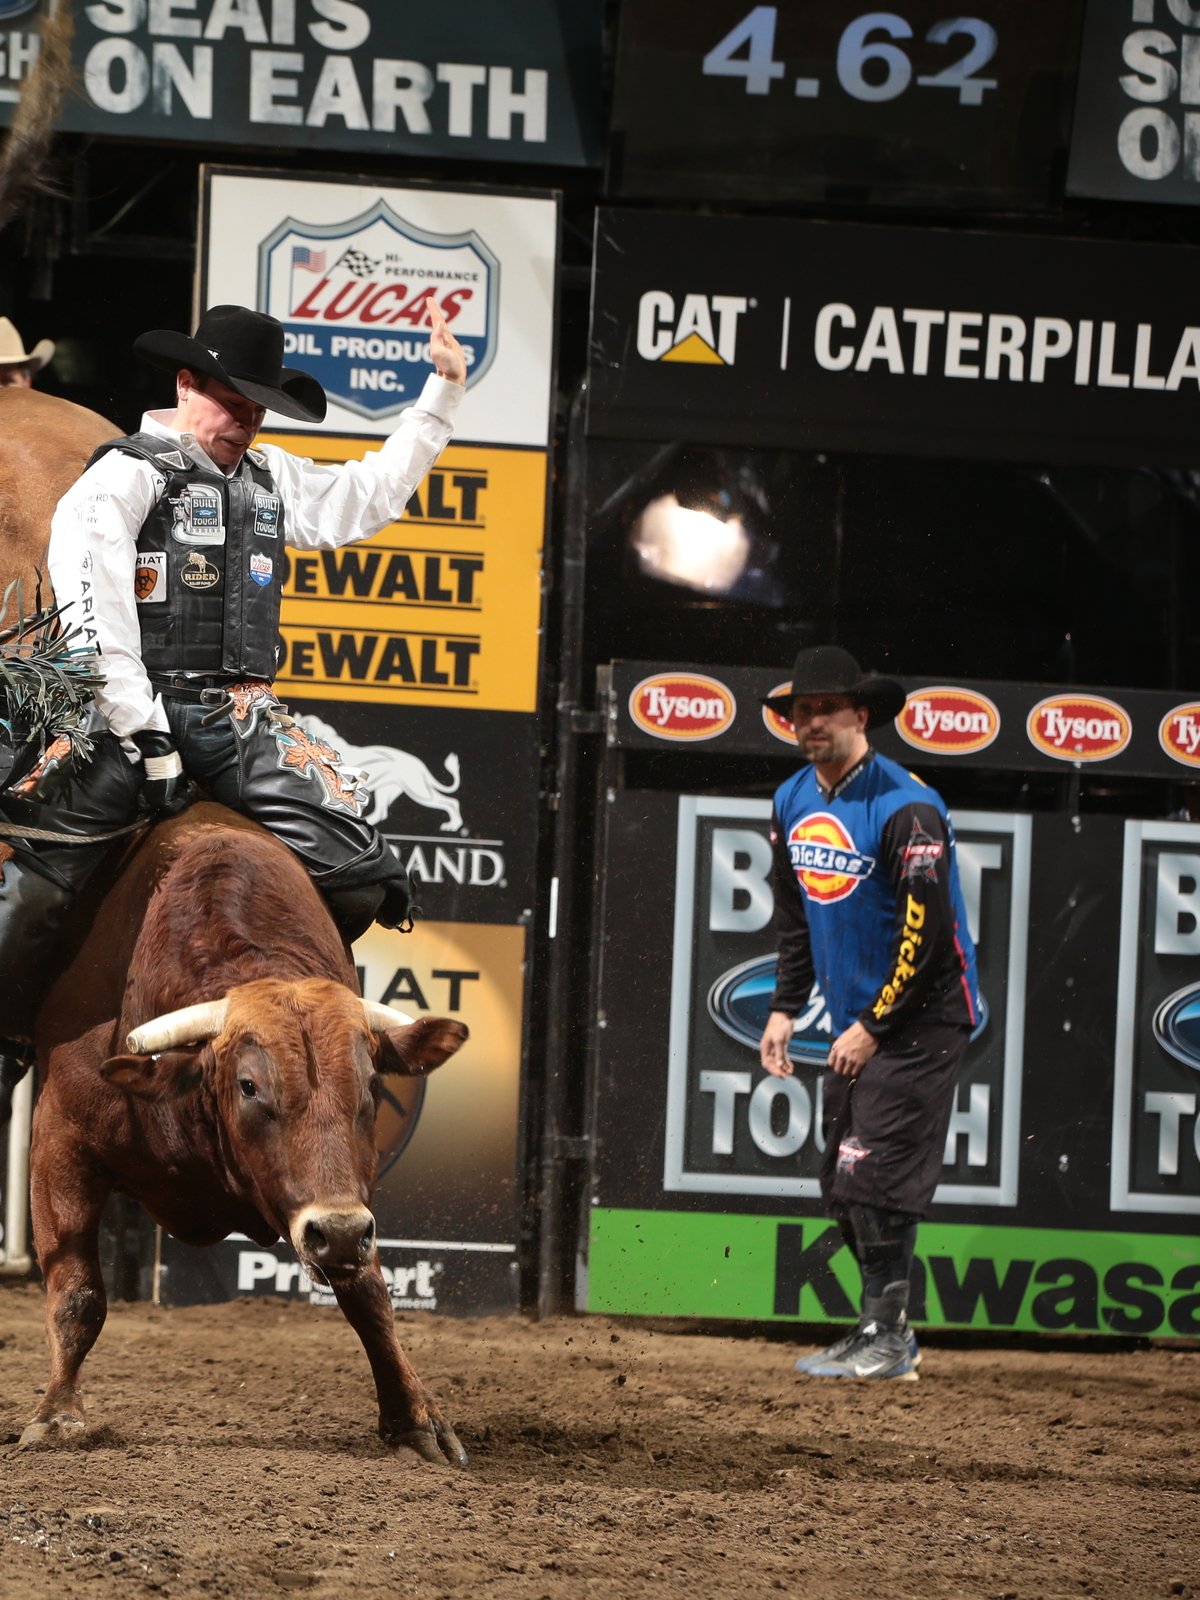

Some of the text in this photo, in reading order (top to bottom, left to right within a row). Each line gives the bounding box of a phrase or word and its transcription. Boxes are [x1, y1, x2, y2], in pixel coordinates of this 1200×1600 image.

[84, 37, 548, 143] ON EARTH
[384, 266, 480, 283] PERFORMANCE
[290, 276, 475, 328] LUCAS
[636, 290, 748, 366] CAT
[330, 335, 476, 366] PRODUCS
[350, 367, 406, 393] INC.
[192, 499, 217, 508] BUILT
[192, 517, 218, 526] TOUGH
[257, 498, 278, 511] BUILT
[256, 522, 276, 534] TOUGH
[184, 573, 216, 581] RIDER
[281, 547, 484, 604] EWALT
[80, 580, 102, 656] ARIAT
[277, 630, 481, 687] EWALT
[643, 686, 725, 726] Tyson
[909, 700, 990, 739] Tyson
[1040, 707, 1122, 746] Tyson
[791, 846, 863, 873] Dickies
[872, 893, 926, 1021] Dickies
[700, 1070, 991, 1166] TOH
[238, 1250, 435, 1298] Prirt
